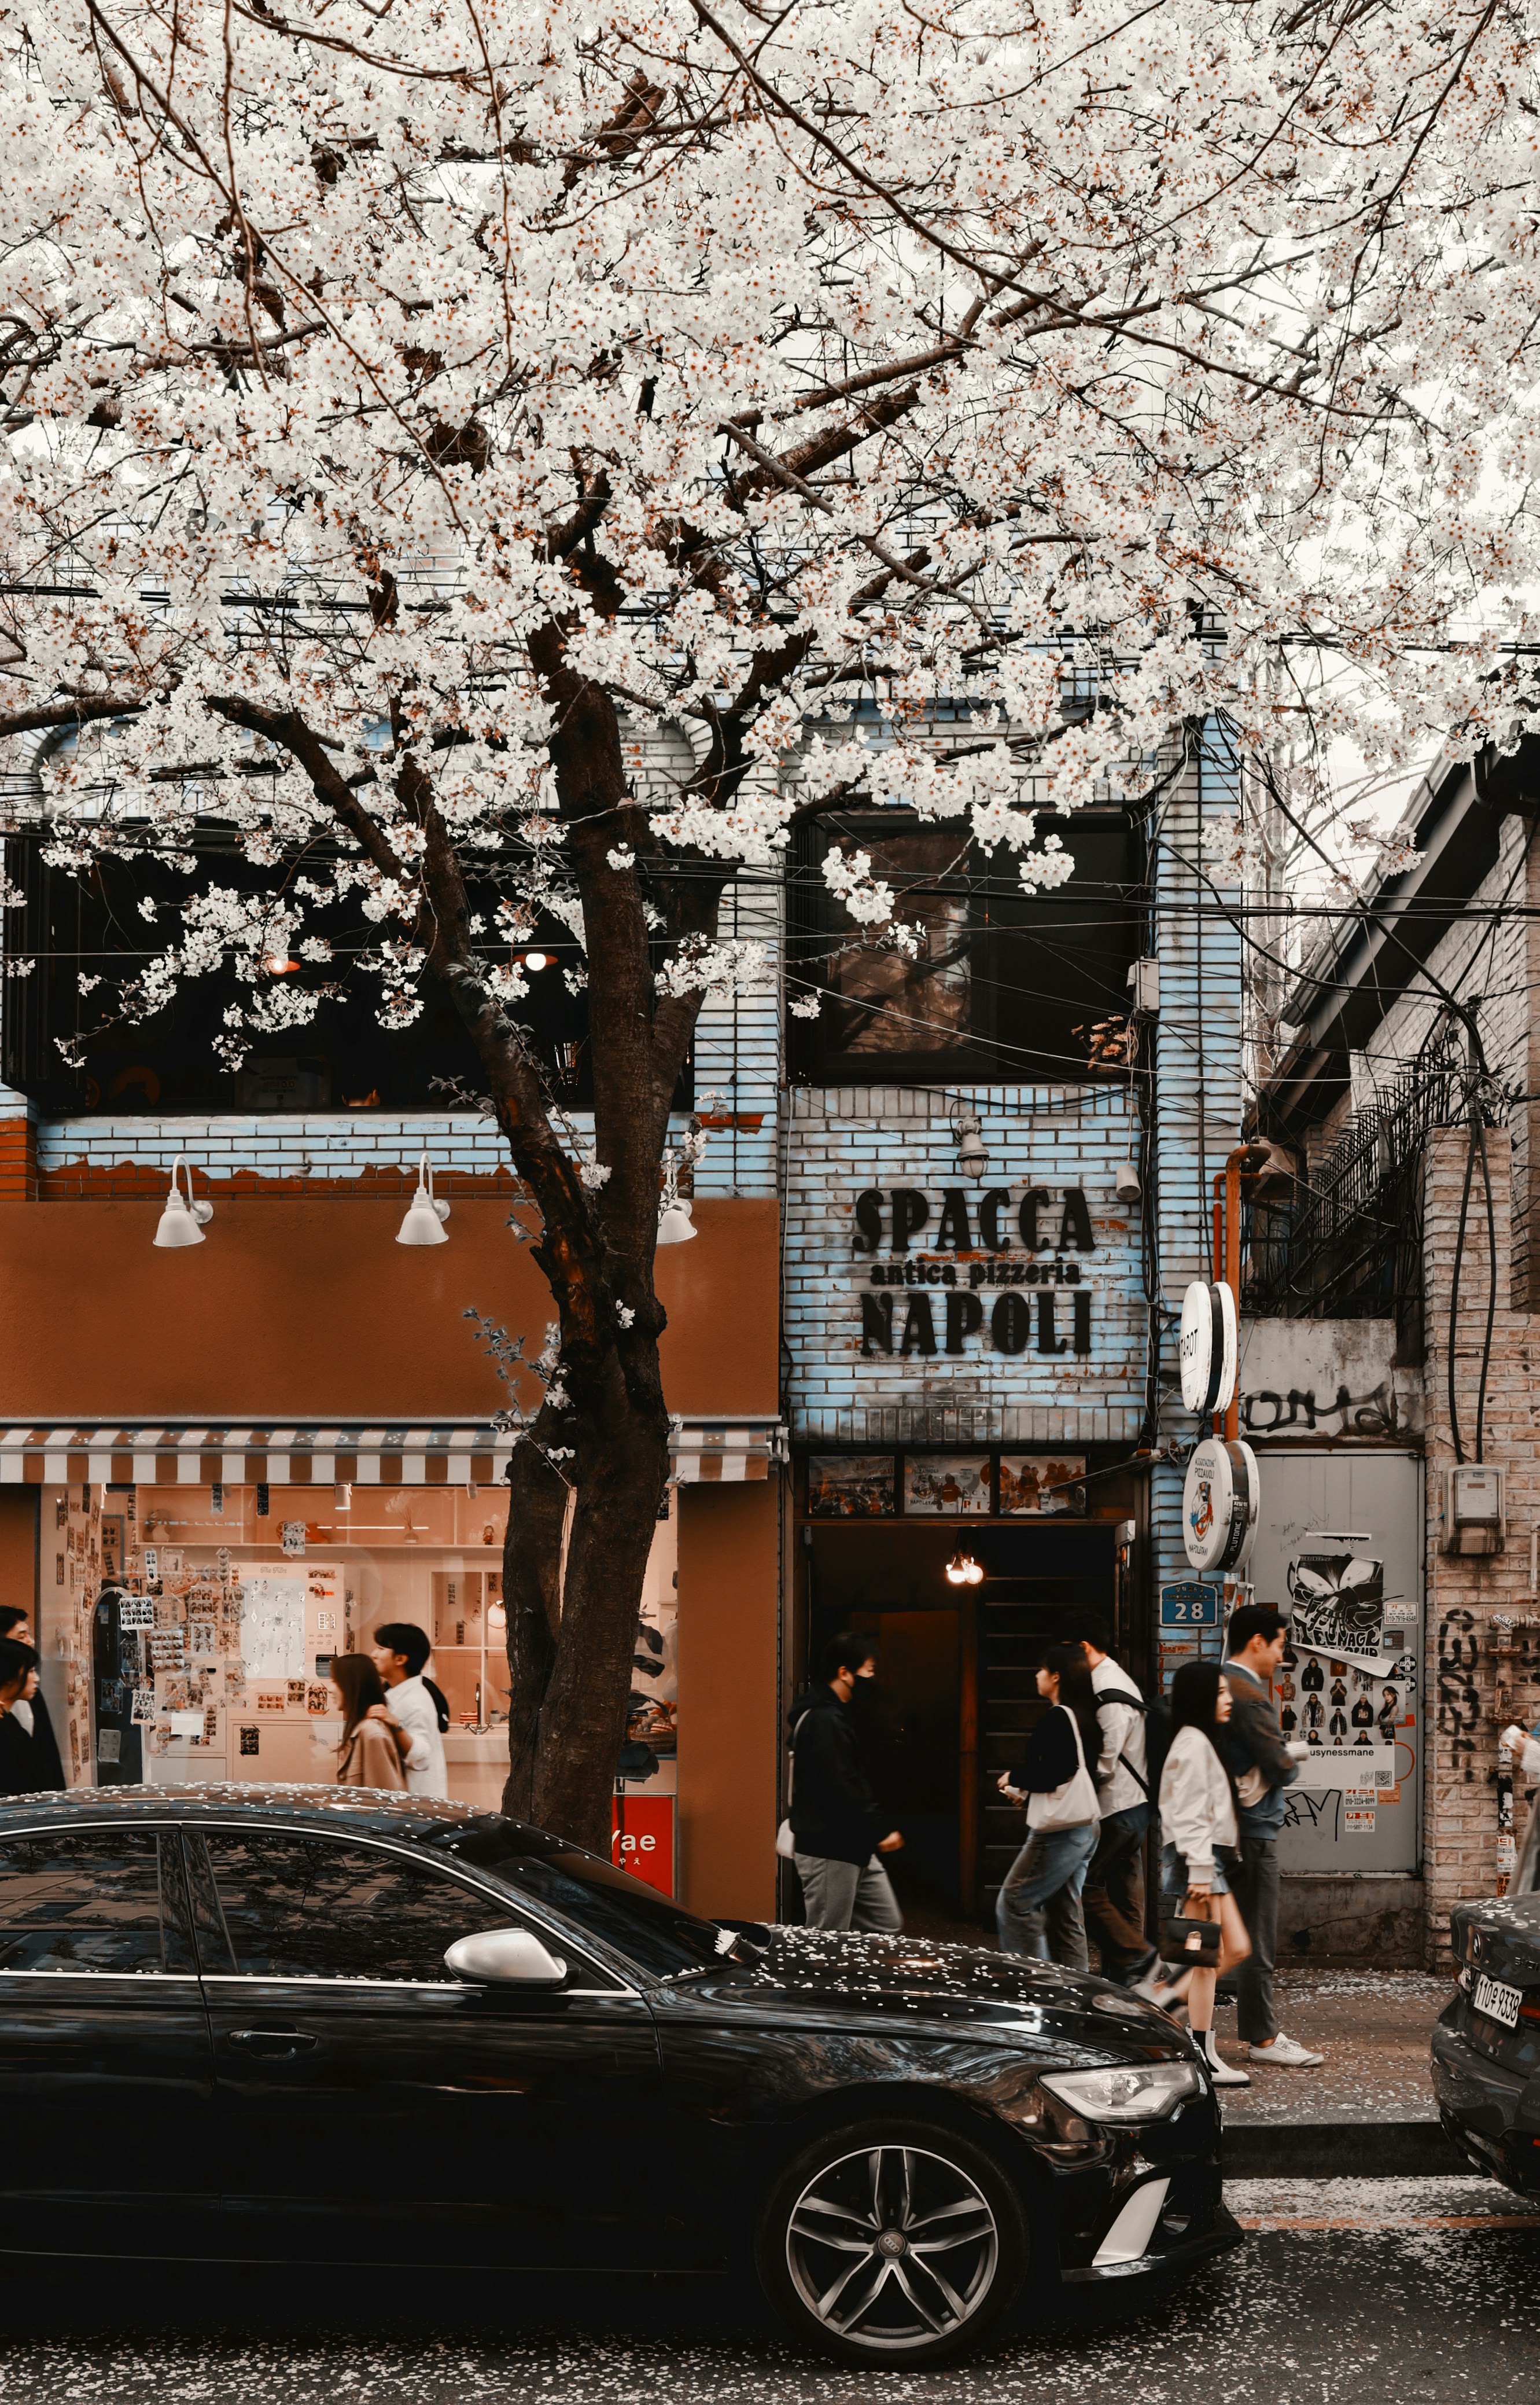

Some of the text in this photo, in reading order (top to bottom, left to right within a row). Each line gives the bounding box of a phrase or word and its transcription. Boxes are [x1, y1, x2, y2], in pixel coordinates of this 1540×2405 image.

[852, 1189, 1095, 1252] SPACCA
[870, 1256, 1081, 1289] antica pizzeria
[860, 1292, 1092, 1355] NAPOLI
[1181, 1328, 1198, 1362] TAROT
[1230, 1521, 1242, 1551] PLUTONIC
[1175, 1602, 1203, 1619] 28
[1310, 1749, 1375, 1759] usynessmane
